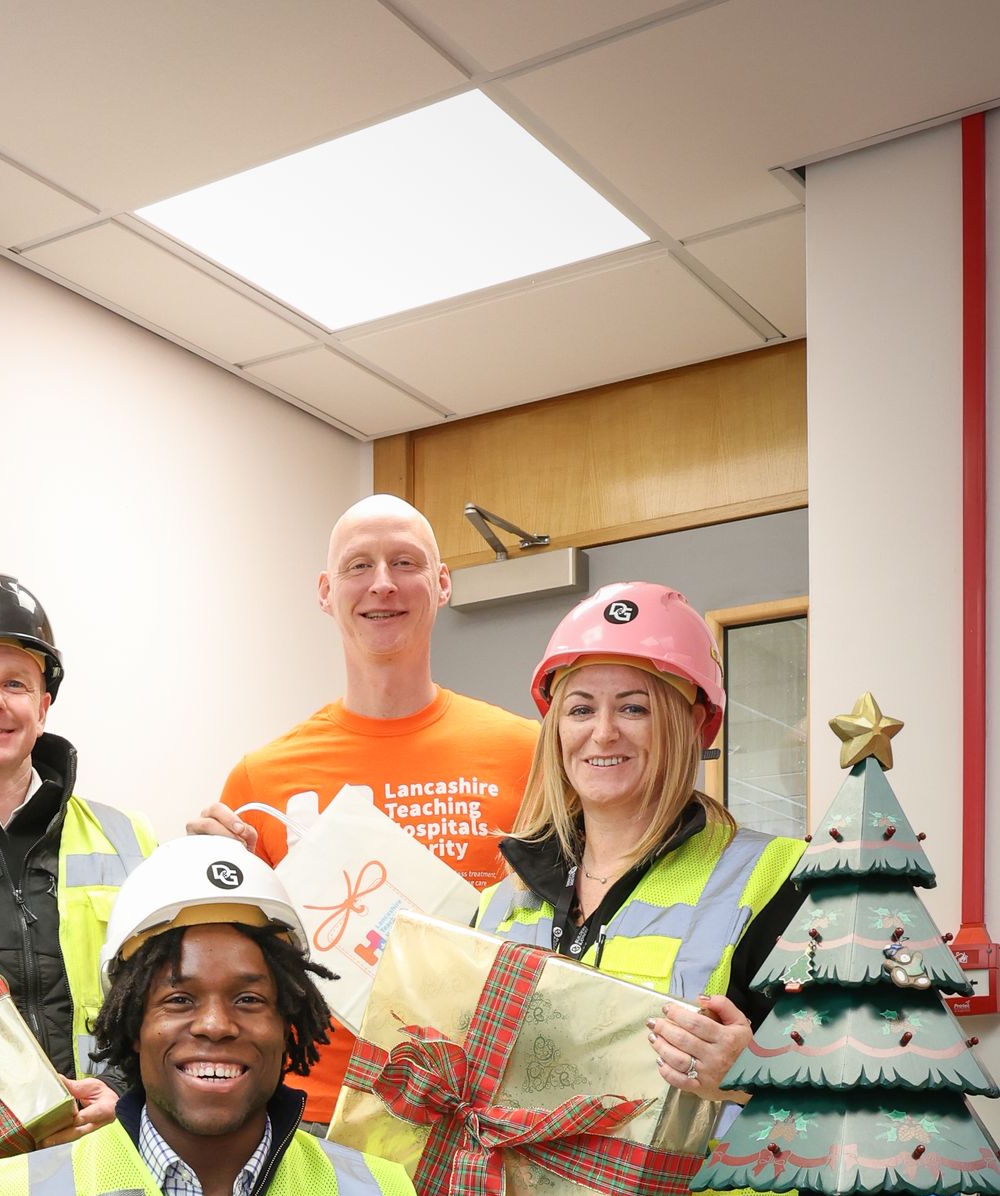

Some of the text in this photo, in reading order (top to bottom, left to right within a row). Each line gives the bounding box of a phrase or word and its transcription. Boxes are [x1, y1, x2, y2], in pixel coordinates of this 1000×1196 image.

[384, 776, 499, 799] Lancashire
[384, 796, 482, 819] Teaching
[397, 817, 489, 840] ospitals
[426, 837, 469, 861] rity
